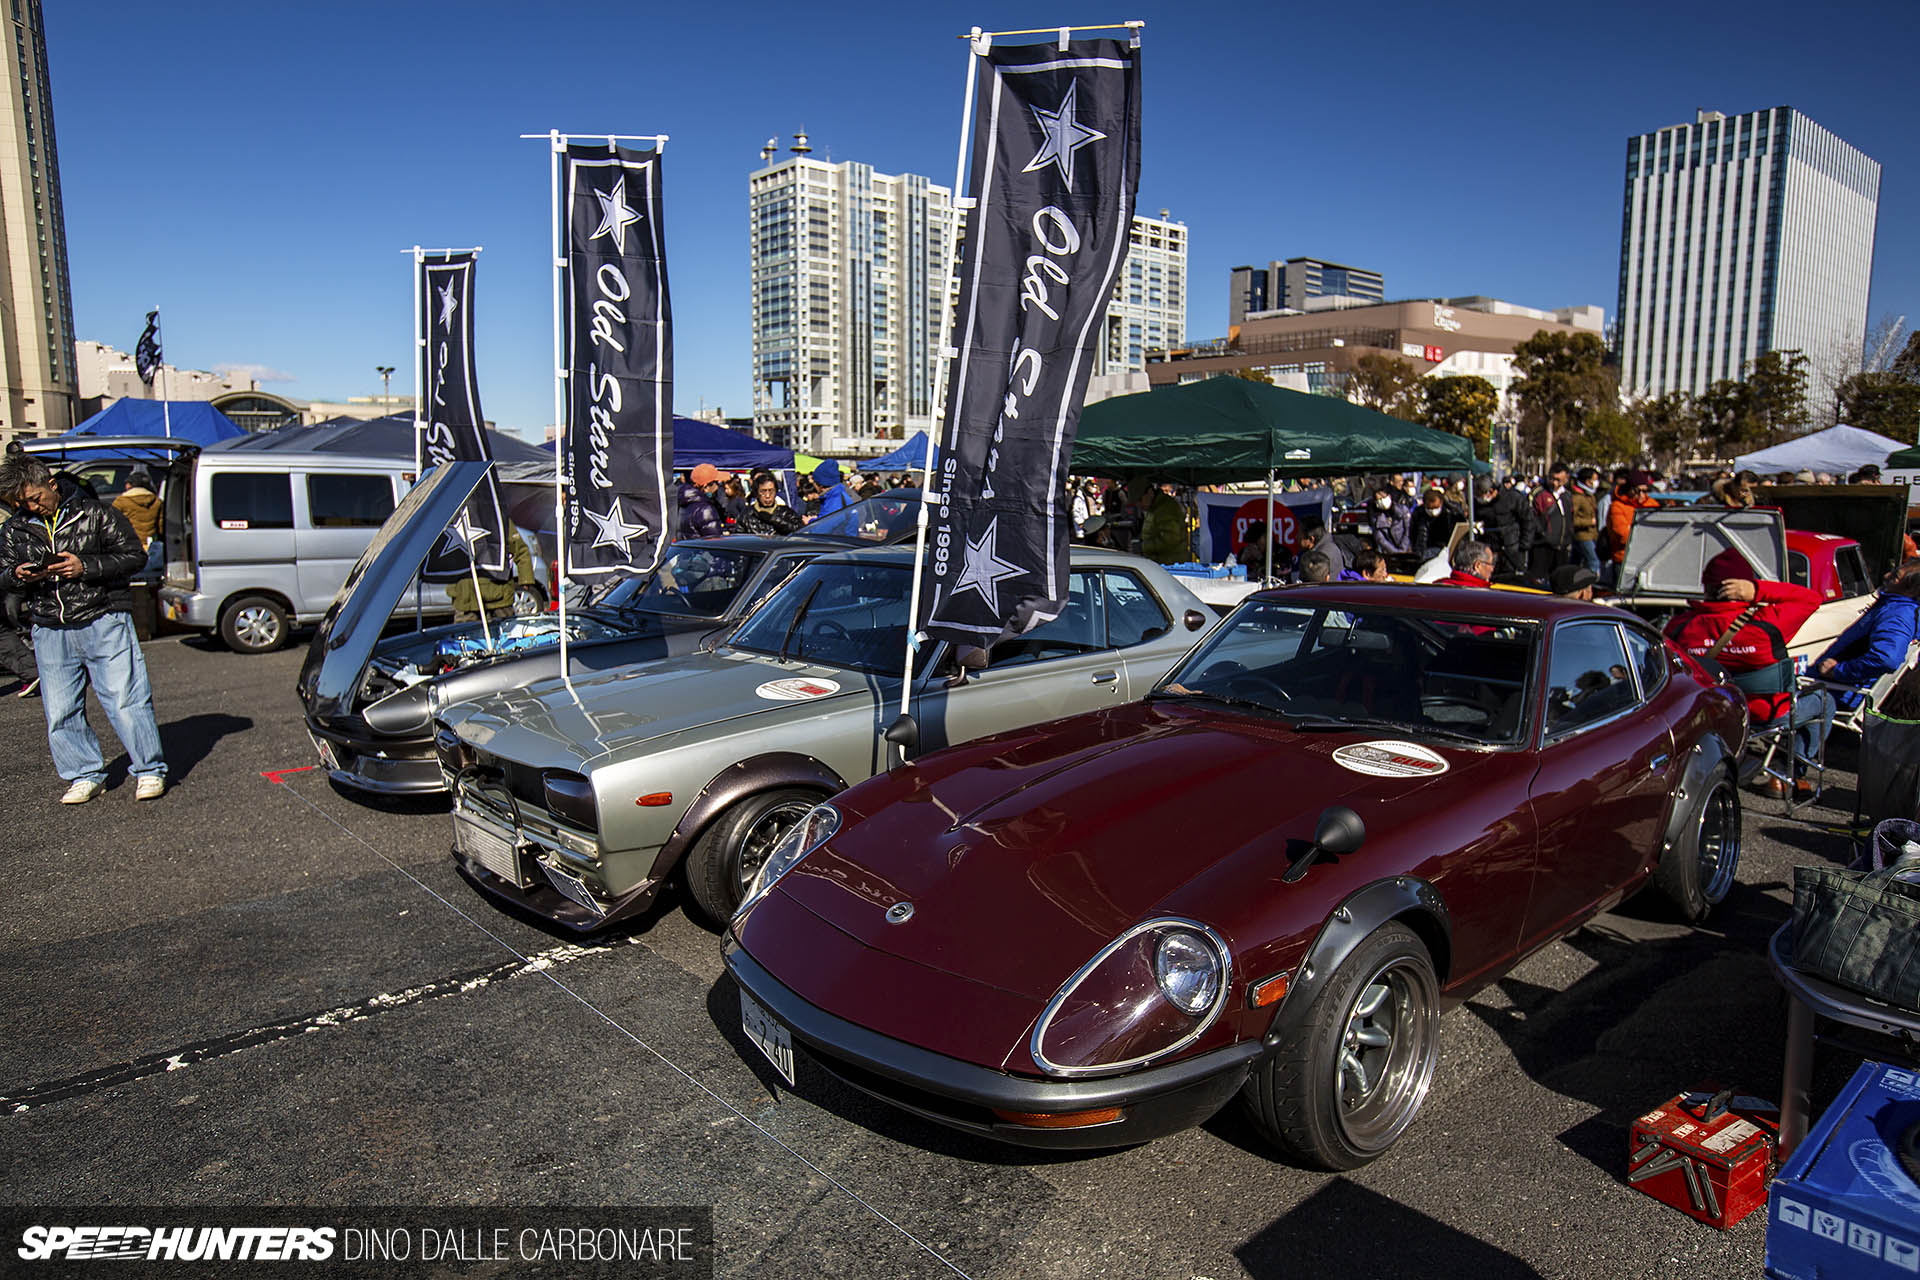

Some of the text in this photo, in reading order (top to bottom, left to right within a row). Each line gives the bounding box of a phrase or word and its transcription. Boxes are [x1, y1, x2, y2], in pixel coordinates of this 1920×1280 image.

[1021, 205, 1080, 321] Old
[589, 262, 631, 490] Old Stars
[934, 457, 957, 577] Since 1999
[1729, 645, 1757, 654] CLUB
